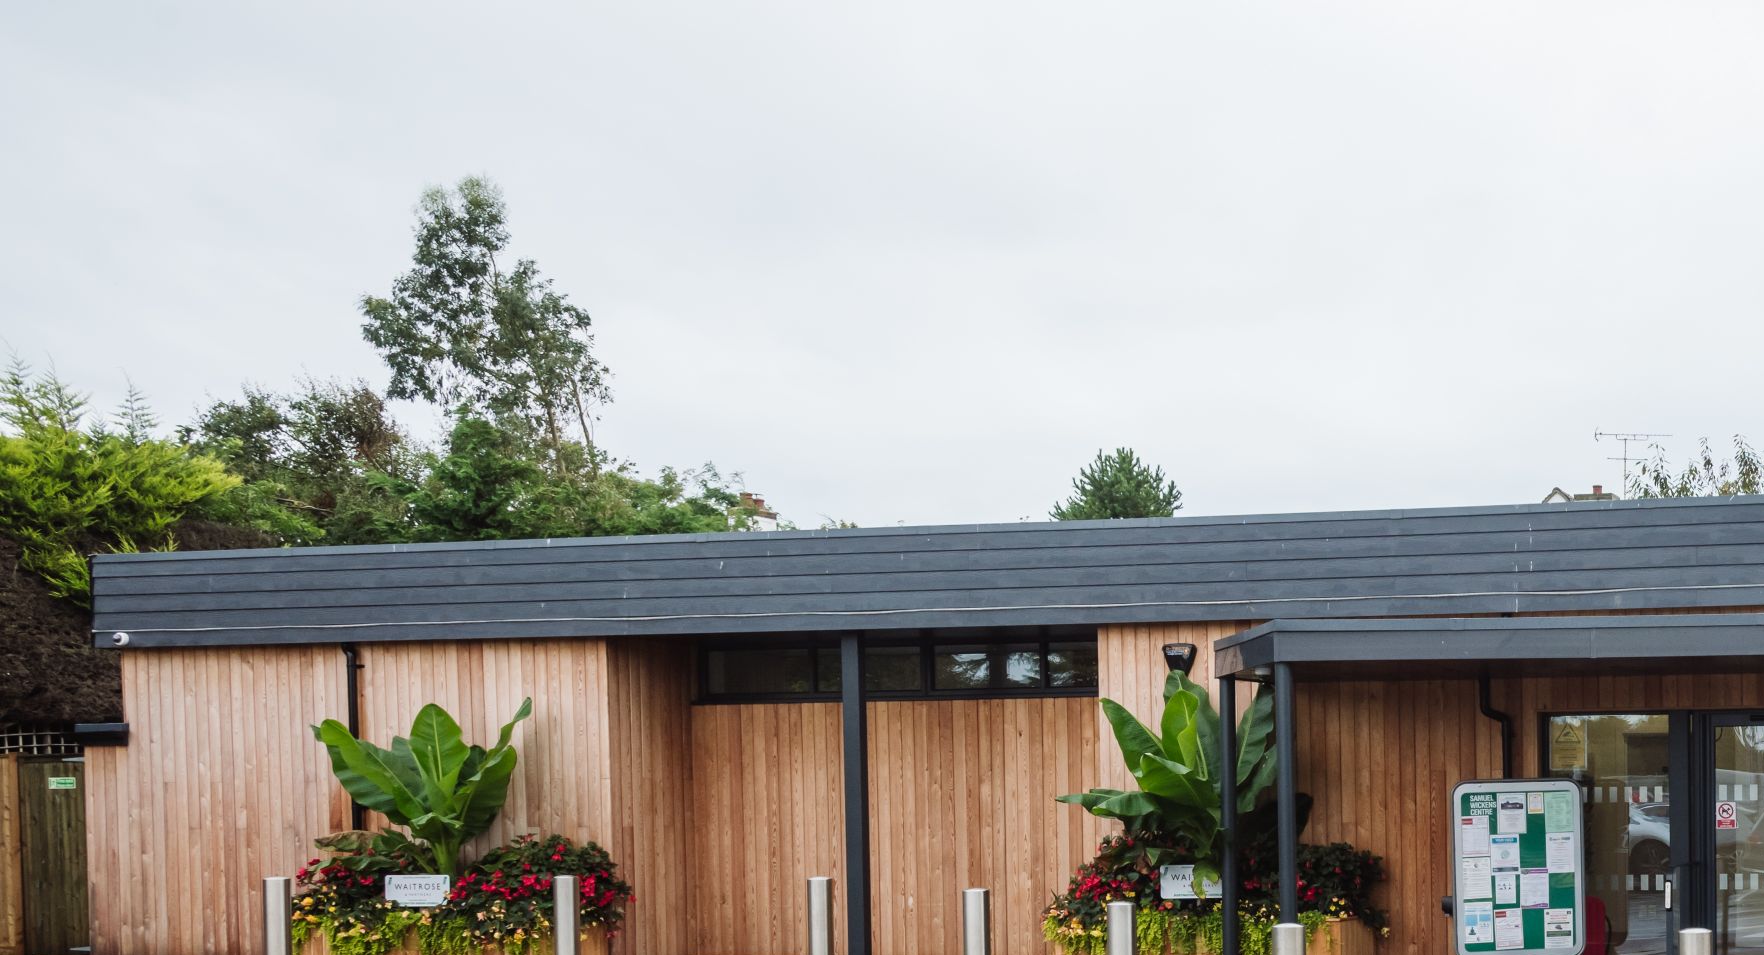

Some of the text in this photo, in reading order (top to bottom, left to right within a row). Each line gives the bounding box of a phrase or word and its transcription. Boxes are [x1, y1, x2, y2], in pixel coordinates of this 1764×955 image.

[1470, 794, 1493, 802] SAMUEL
[1470, 801, 1497, 809] WICKENS
[1471, 808, 1493, 816] CENTRE
[394, 883, 441, 891] WAITROSE
